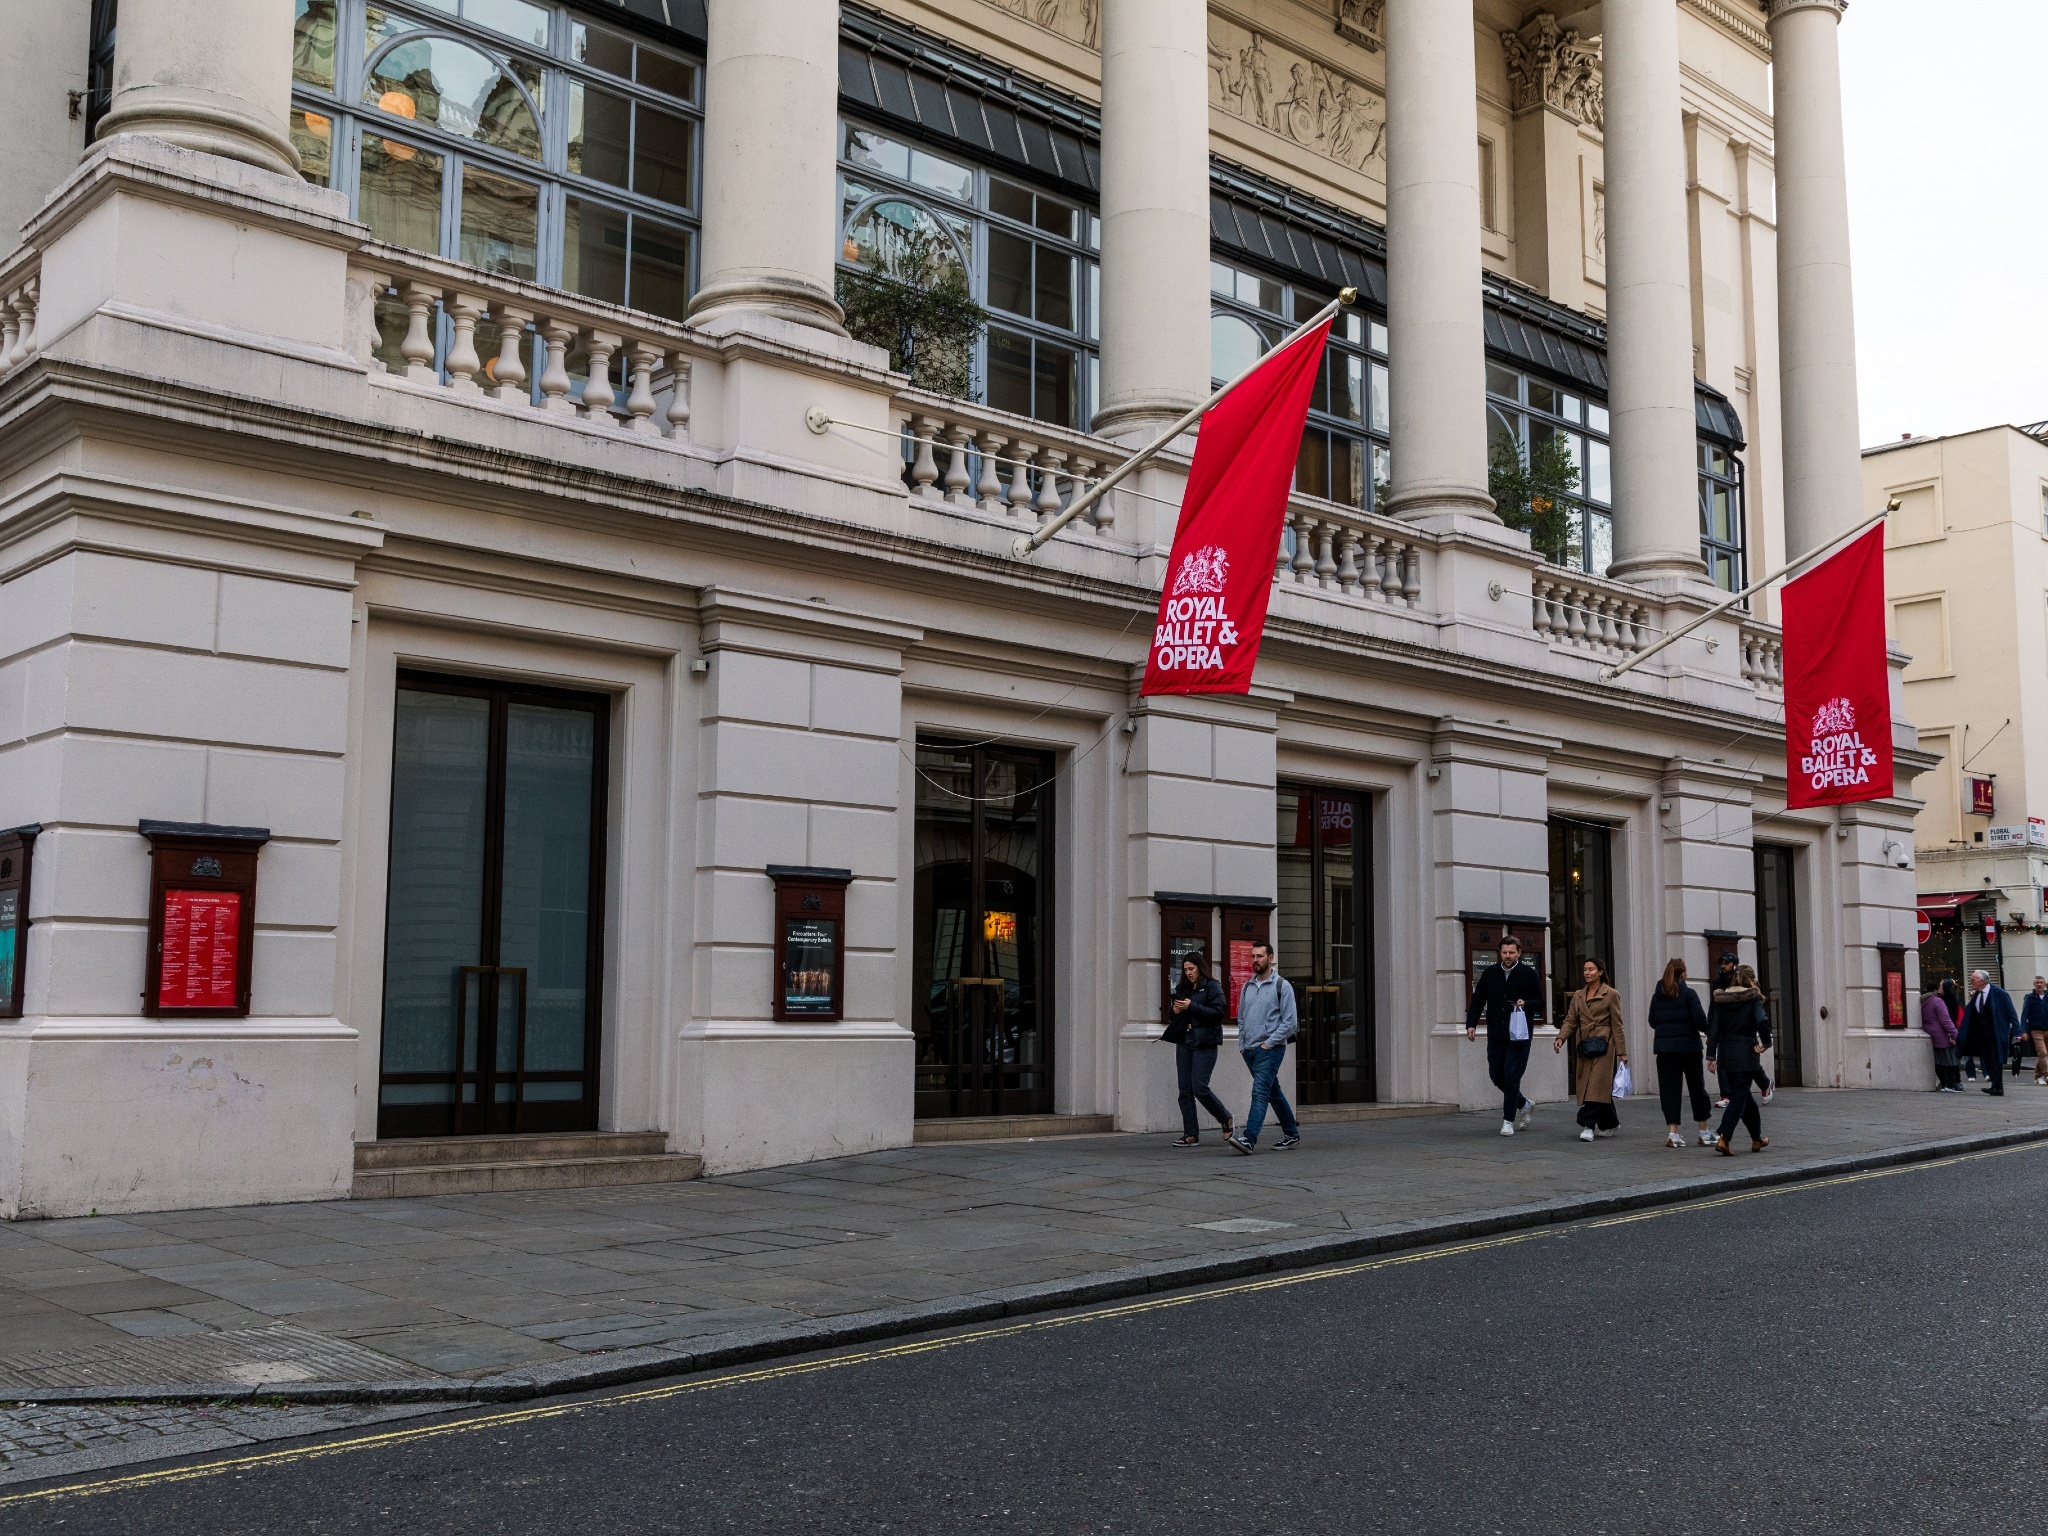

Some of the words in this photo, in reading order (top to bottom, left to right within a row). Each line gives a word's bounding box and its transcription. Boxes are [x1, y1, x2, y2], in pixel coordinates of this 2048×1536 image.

[1166, 597, 1228, 623] ROYAL
[1154, 621, 1217, 648] BALLET
[1218, 621, 1239, 646] &
[1157, 645, 1224, 671] OPERA
[1811, 732, 1865, 756] ROYAL
[1802, 750, 1856, 773] BALLET
[1861, 748, 1877, 765] &
[1812, 767, 1869, 789] OPERA
